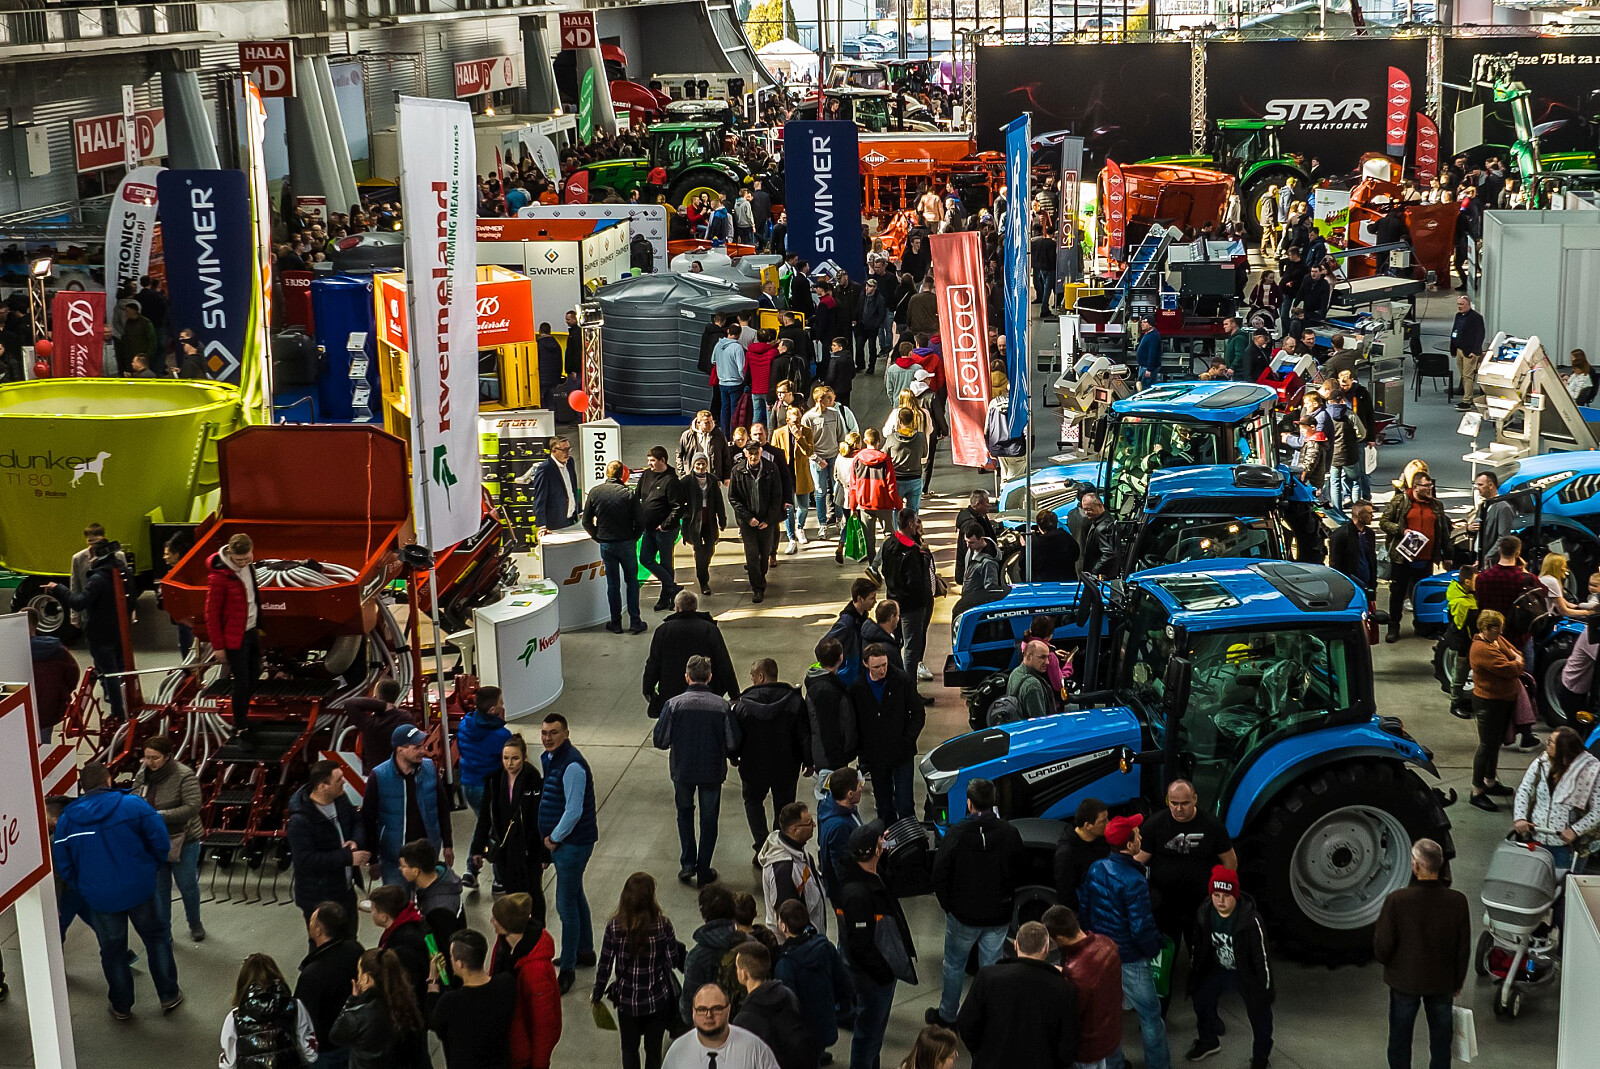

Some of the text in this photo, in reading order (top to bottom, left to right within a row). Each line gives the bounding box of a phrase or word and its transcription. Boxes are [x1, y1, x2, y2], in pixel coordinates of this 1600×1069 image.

[563, 16, 591, 26] HALA
[576, 28, 592, 46] D
[244, 46, 285, 60] HALA
[1541, 53, 1556, 65] 75
[1558, 53, 1576, 65] lat
[1577, 56, 1593, 64] za
[262, 64, 286, 91] D
[456, 64, 480, 86] HALA
[1263, 98, 1370, 121] STEYR
[1300, 122, 1367, 130] TRAKTOREN
[449, 179, 459, 218] MEANS
[811, 135, 834, 253] SWIMER
[446, 220, 458, 271] FARMING
[190, 187, 226, 329] SWIMER
[529, 267, 575, 276] SWIMER
[496, 418, 538, 428] STORTI
[593, 431, 607, 480] Polska
[28, 473, 53, 487] 80
[261, 602, 287, 610] eland
[986, 609, 1030, 620] LANDINI
[1028, 761, 1070, 779] LANDINI
[1213, 880, 1233, 891] WILD
